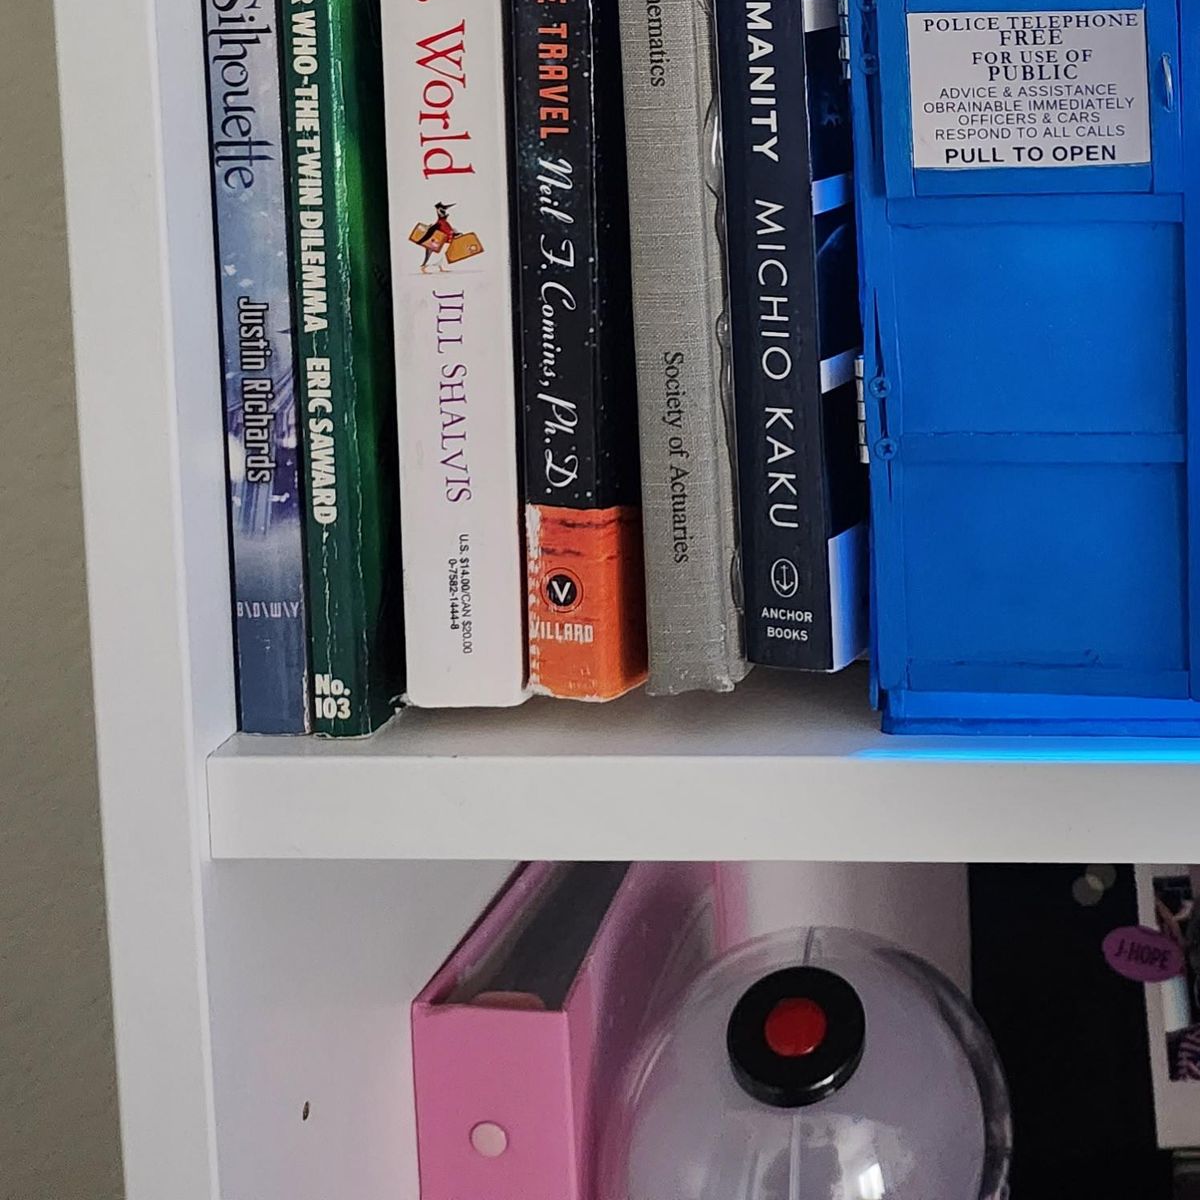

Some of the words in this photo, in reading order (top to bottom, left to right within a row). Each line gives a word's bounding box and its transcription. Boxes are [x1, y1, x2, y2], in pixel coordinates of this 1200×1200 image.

[923, 17, 1000, 32] POLICE
[1006, 13, 1138, 30] TELEPHONE
[999, 29, 1064, 46] FREE
[972, 51, 1013, 65] FOR
[1020, 50, 1058, 64] USE
[1066, 49, 1093, 63] OF
[988, 64, 1079, 82] PUBLIC
[537, 22, 570, 139] TRAVEL
[939, 86, 998, 99] ADVICE
[1002, 86, 1013, 98] &
[1018, 83, 1118, 97] ASSISTANCE
[415, 19, 476, 181] World
[923, 100, 1022, 113] OBRAINABLE
[1028, 97, 1135, 111] IMMEDIATELY
[935, 128, 1012, 140] RESPOND
[1016, 127, 1038, 139] TO
[1042, 126, 1071, 138] ALL
[1075, 125, 1126, 137] CALLS
[958, 113, 1037, 126] OFFICERS
[1042, 113, 1052, 124] &
[1057, 111, 1100, 123] CARS
[296, 135, 324, 206] TWIN
[945, 147, 1005, 164] PULL
[1012, 146, 1044, 161] TO
[1052, 145, 1117, 162] OPEN
[537, 157, 574, 224] Neil
[300, 211, 328, 333] DILEMMA
[754, 198, 793, 382] MICHIO
[238, 297, 272, 370] Justin
[432, 289, 465, 355] JILL
[539, 282, 576, 386] Comins,
[306, 357, 333, 414] ERIC
[662, 351, 686, 428] Society
[242, 378, 277, 483] Richards
[438, 363, 473, 503] SHALVIS
[668, 436, 690, 457] of
[308, 418, 338, 524] SAWARD
[764, 407, 800, 530] KAKU
[670, 465, 694, 564] Actuaries
[458, 533, 470, 555] U.S.
[448, 558, 460, 630] 0-7582-1444-8
[551, 580, 571, 603] V
[761, 607, 813, 624] ANCHOR
[462, 620, 473, 654] $20.00
[530, 621, 594, 644] VILLARD
[766, 626, 809, 642] BOOKS
[315, 674, 350, 696] No.
[315, 698, 351, 719] 103
[1113, 938, 1172, 971] J-HOPE
